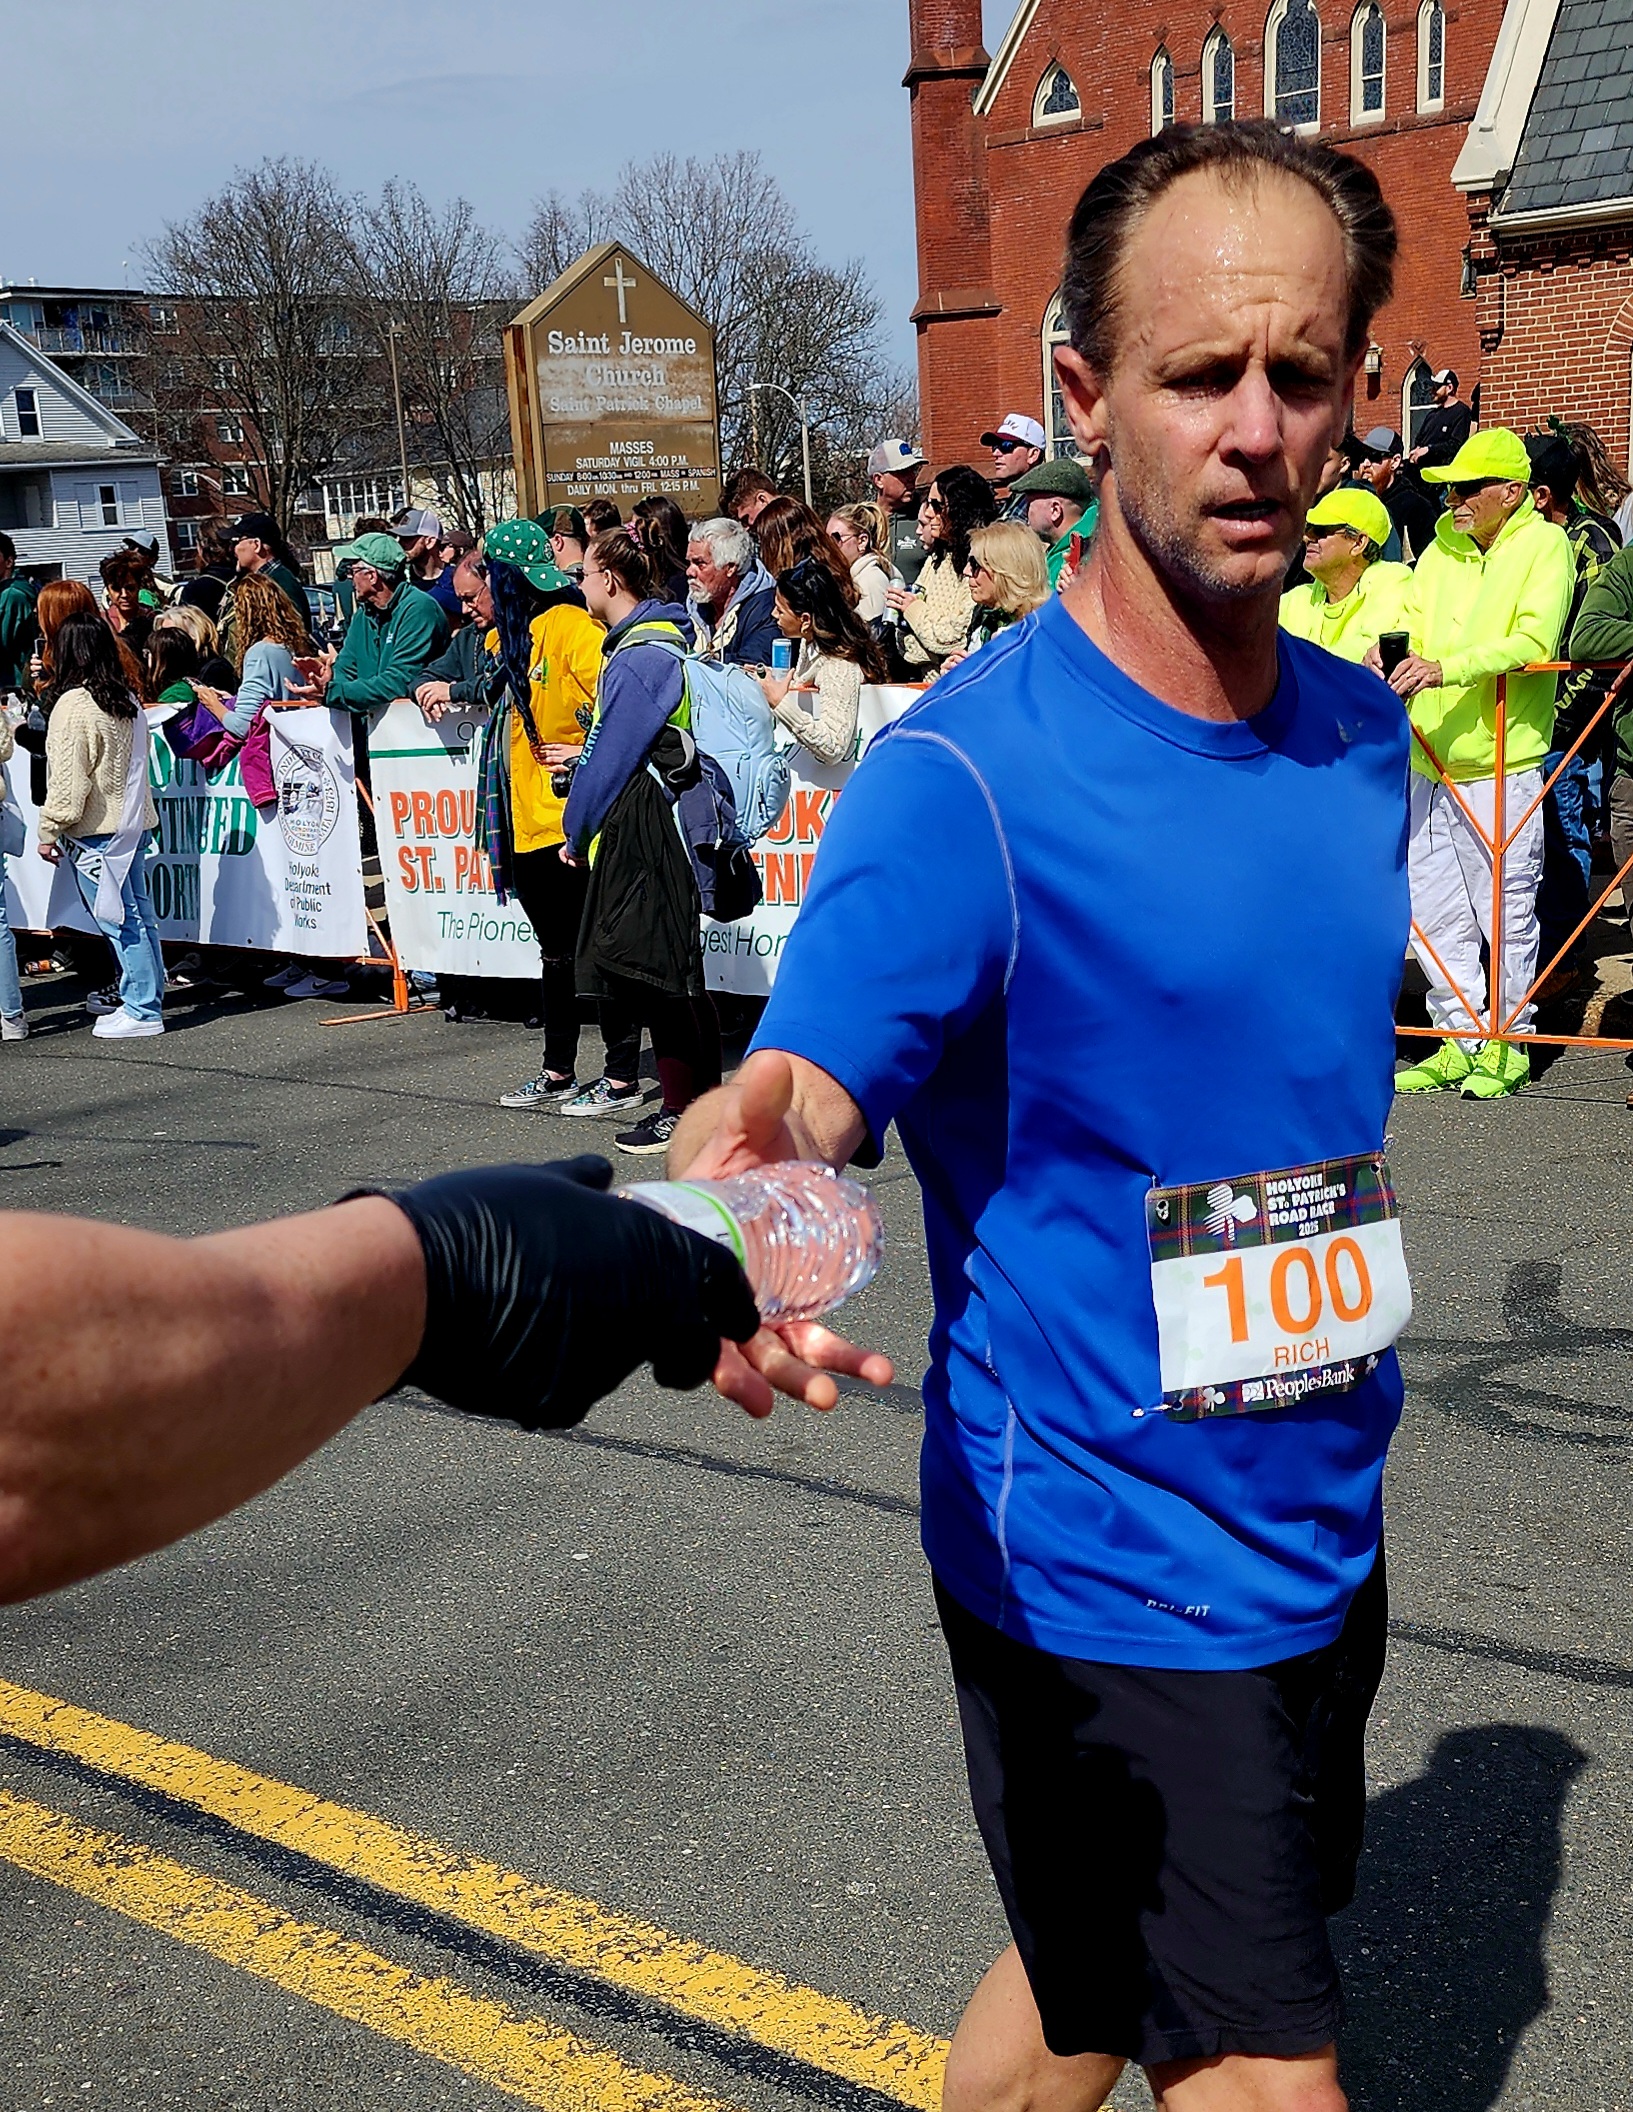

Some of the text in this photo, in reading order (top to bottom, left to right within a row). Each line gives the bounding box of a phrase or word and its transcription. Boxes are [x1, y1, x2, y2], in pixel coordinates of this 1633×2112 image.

[548, 330, 696, 354] Saint Jerome
[586, 363, 665, 387] Church
[551, 395, 702, 413] Saint Patrick Chapel
[610, 441, 654, 455] MASSES
[546, 472, 574, 482] SUNDAY
[660, 469, 680, 478] MASS
[687, 468, 717, 477] SPANISH
[576, 455, 688, 469] SATURDAY VIGIL 4:00 P.M.
[567, 484, 591, 496] DAILY
[621, 483, 638, 494] thru
[682, 480, 700, 491] P.M.
[145, 796, 257, 856] NTINUED
[390, 789, 475, 838] PROU
[398, 845, 495, 893] ST. PA
[284, 877, 332, 895] Deartment
[437, 911, 539, 942] The Pione
[700, 929, 732, 955] gest
[1266, 1173, 1323, 1197] HOLYOKE
[1267, 1183, 1347, 1212] ST. PATRICK'S
[1269, 1200, 1336, 1227] ROAD RACE
[1203, 1235, 1374, 1344] 100
[1273, 1337, 1331, 1368] RICH
[1265, 1362, 1356, 1401] PeoplesBank
